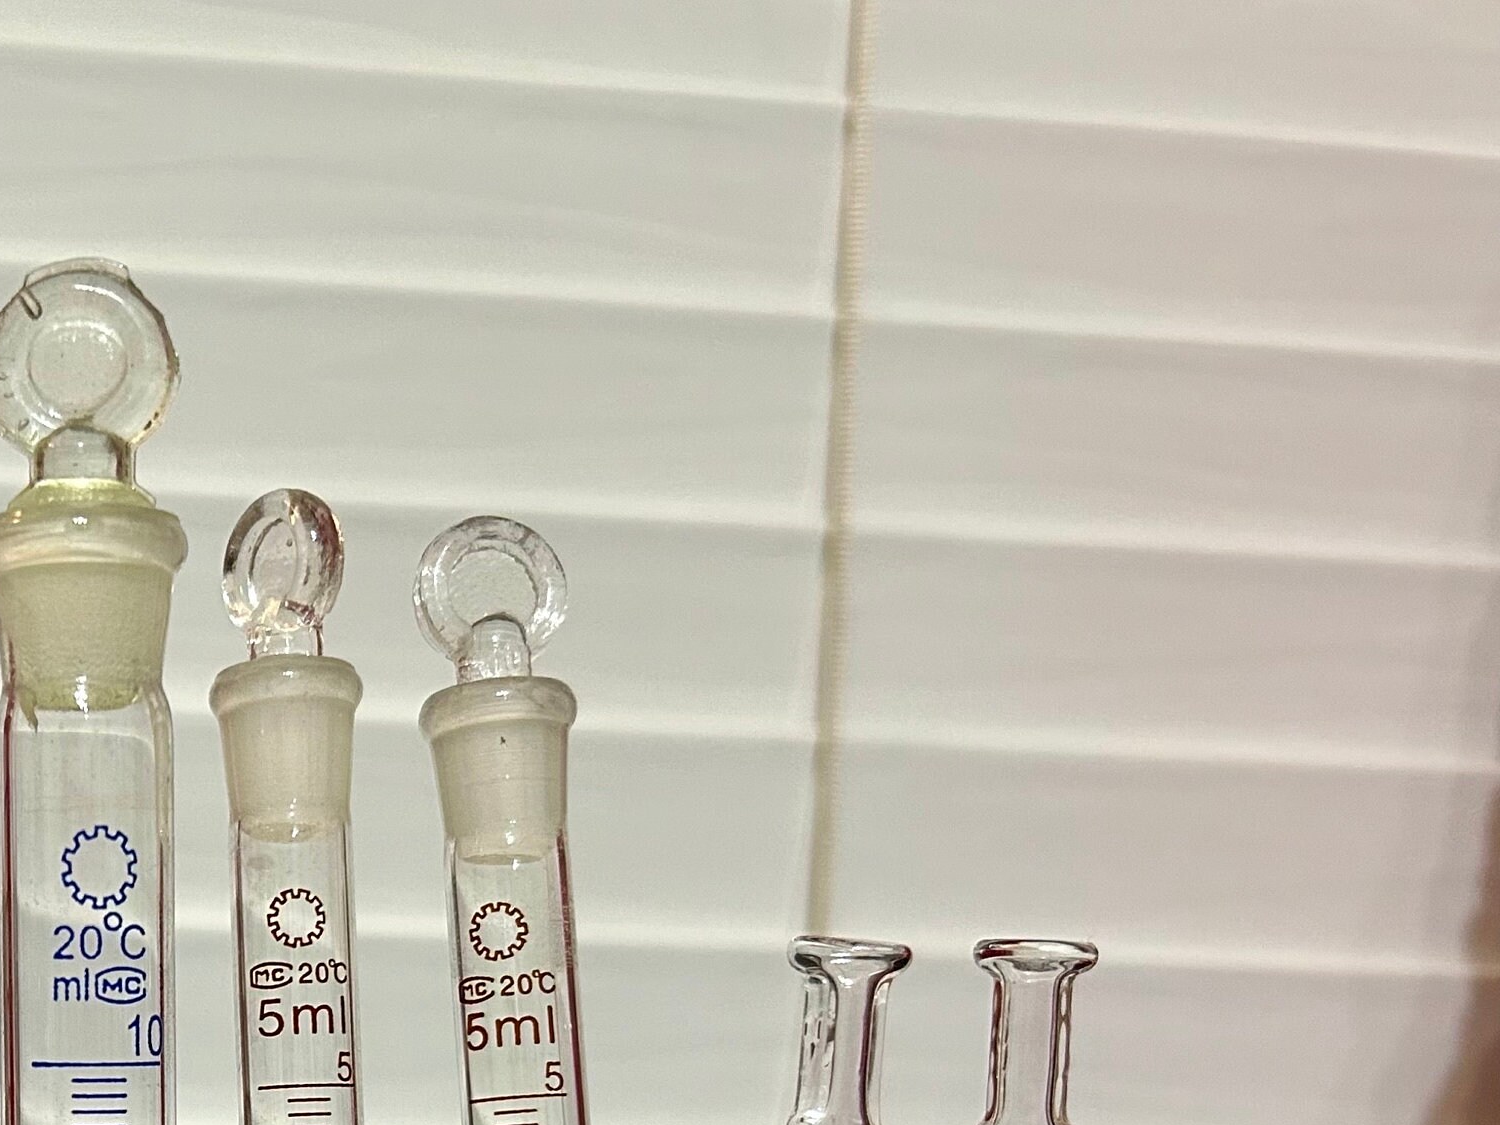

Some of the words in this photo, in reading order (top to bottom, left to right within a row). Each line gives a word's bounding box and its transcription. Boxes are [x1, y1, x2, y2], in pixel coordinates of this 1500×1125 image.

[53, 968, 89, 1002] ml
[258, 995, 347, 1037] 5ml
[466, 1004, 556, 1051] 5ml
[127, 1014, 164, 1057] 10
[337, 1051, 353, 1082] 5
[544, 1061, 565, 1092] 5
